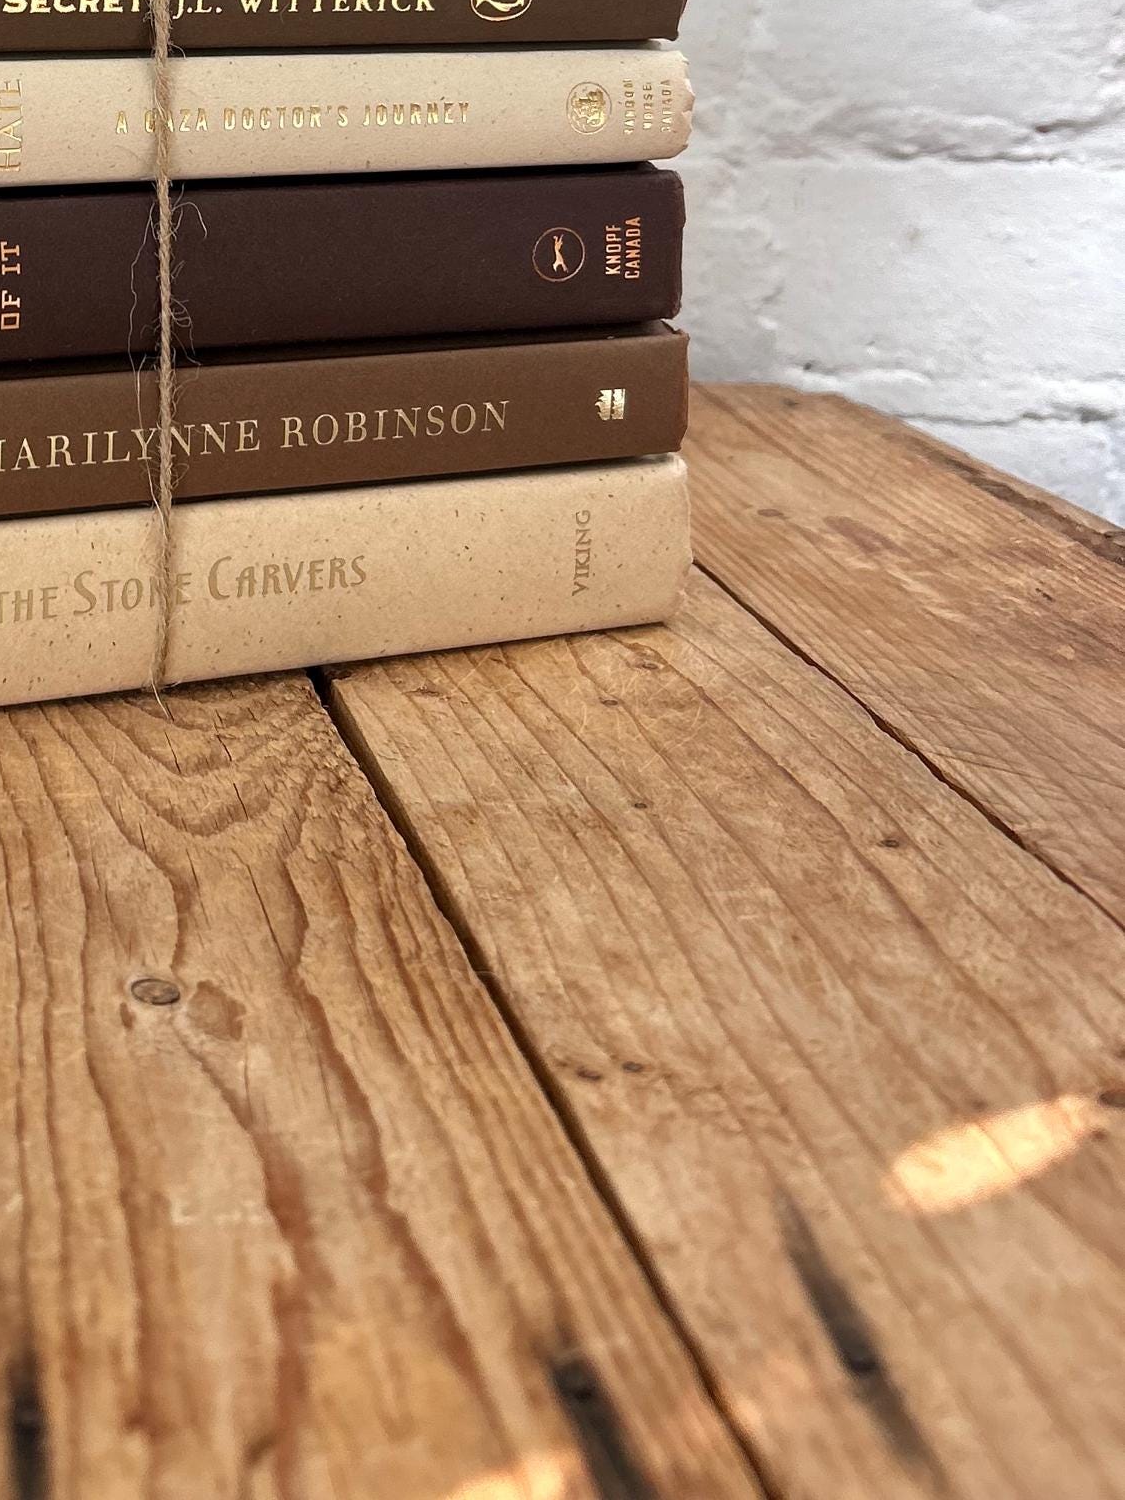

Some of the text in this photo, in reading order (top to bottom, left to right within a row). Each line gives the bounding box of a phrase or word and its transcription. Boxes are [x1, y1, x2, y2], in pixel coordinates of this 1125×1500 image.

[115, 110, 128, 134] A
[223, 104, 349, 131] DOCTOR'S
[362, 102, 469, 127] JOURNEY
[605, 224, 622, 275] KNOPF
[625, 216, 641, 279] CANADA
[0, 240, 21, 330] OF IT
[280, 400, 511, 449] ROBINSON
[207, 555, 367, 601] CARVERS
[571, 509, 592, 597] VIKING
